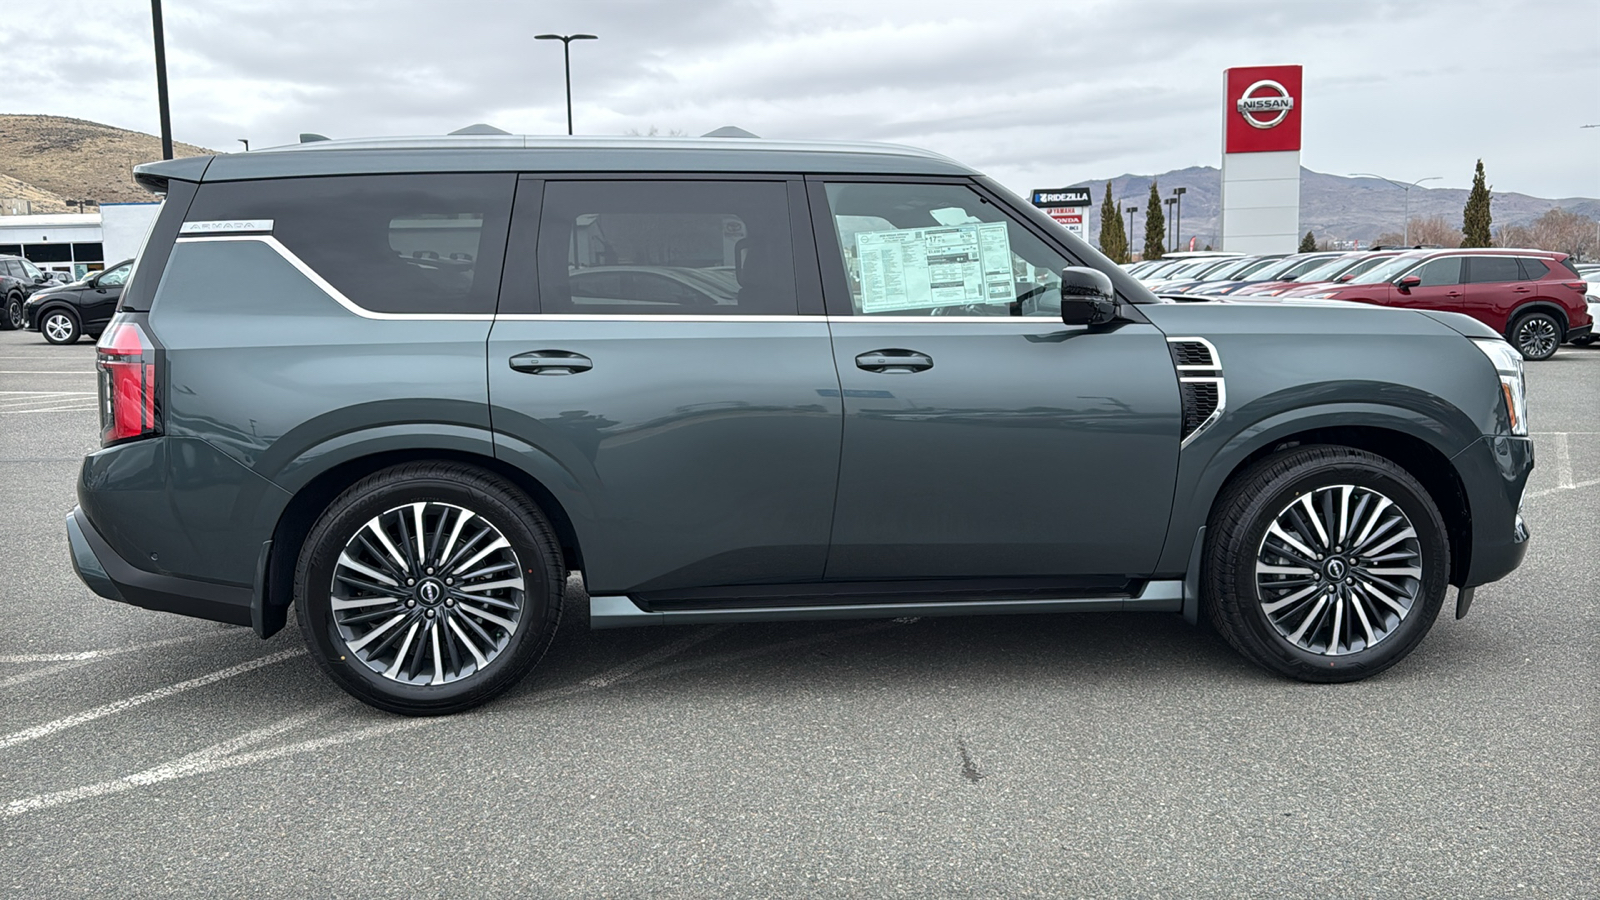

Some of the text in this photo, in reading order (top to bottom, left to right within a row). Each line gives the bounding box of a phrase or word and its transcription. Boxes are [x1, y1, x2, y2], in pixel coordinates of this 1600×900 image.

[1243, 99, 1289, 108] NISSAN
[1047, 192, 1088, 202] RIDEZILLA
[190, 222, 255, 230] ARMADA
